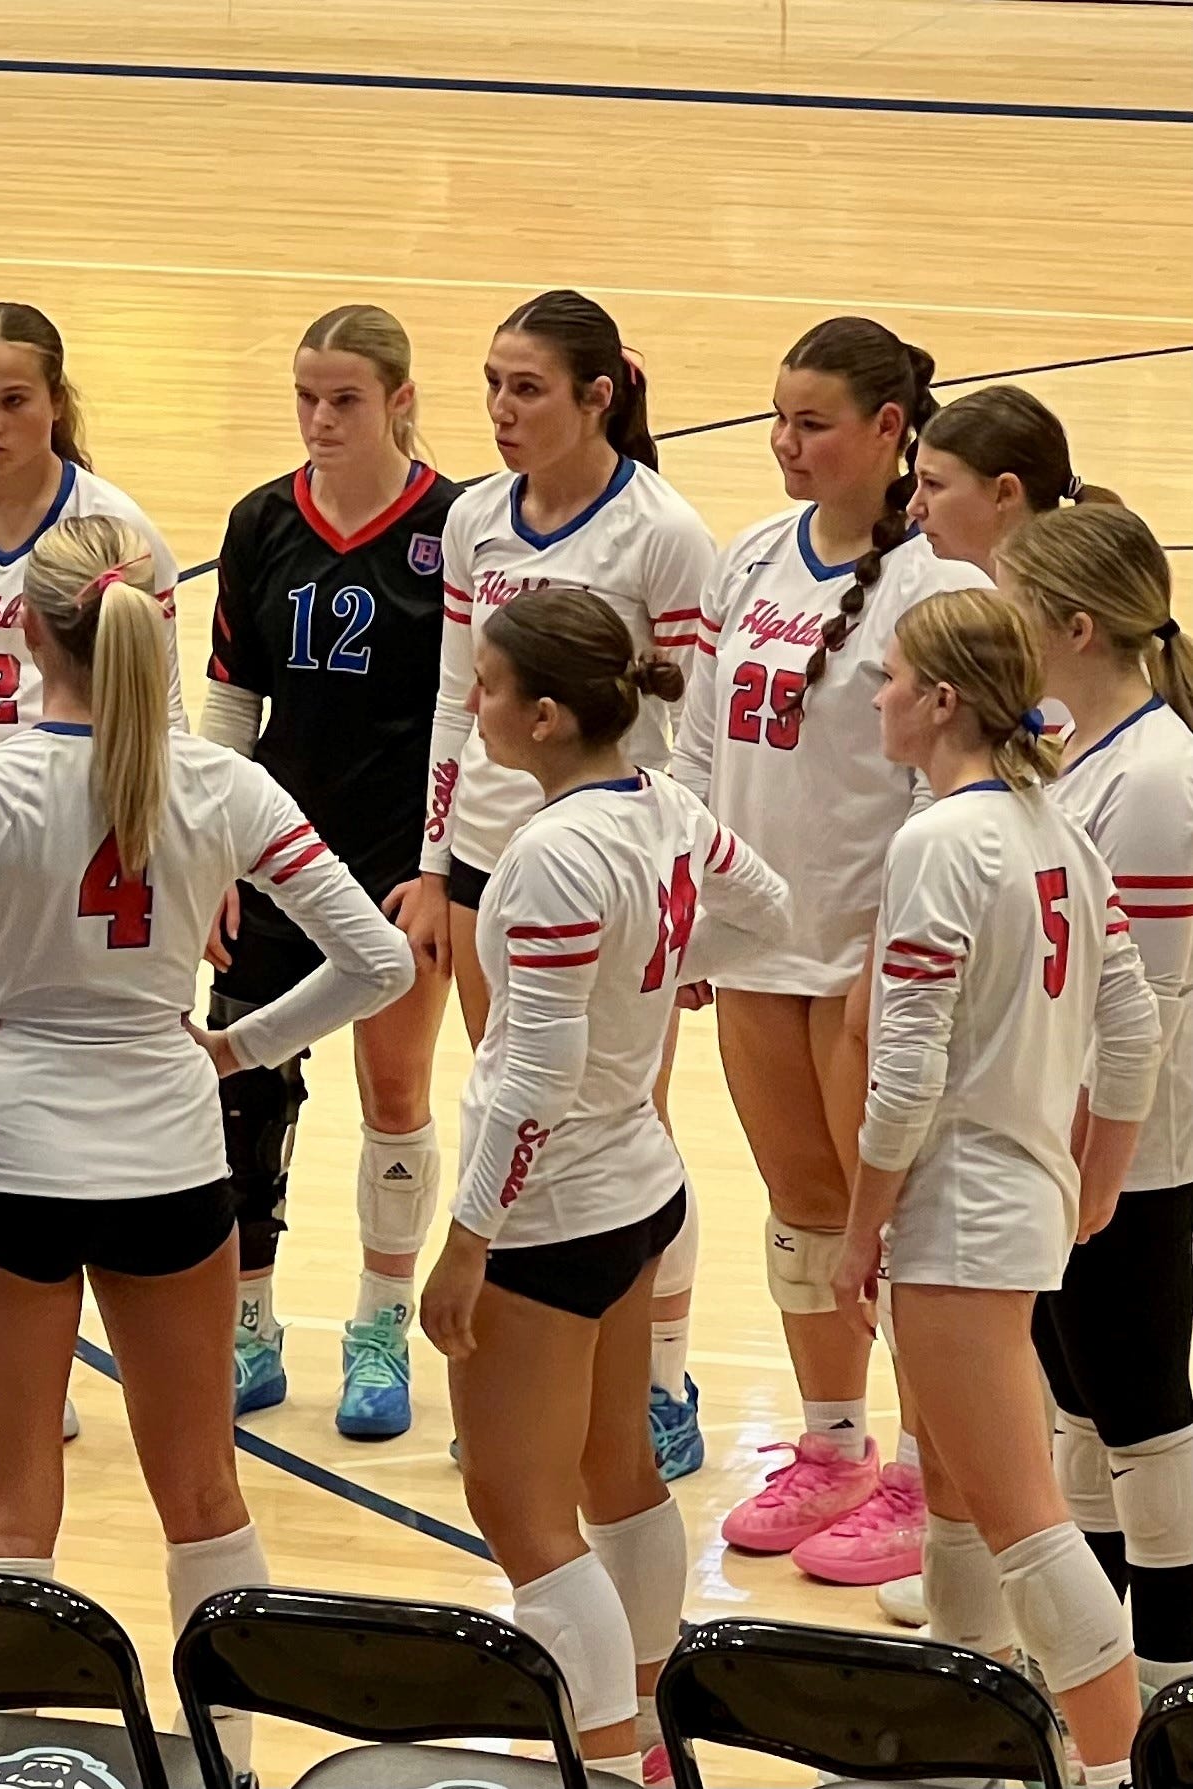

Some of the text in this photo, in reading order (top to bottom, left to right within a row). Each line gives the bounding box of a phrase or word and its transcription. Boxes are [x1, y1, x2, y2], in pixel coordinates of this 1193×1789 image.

[287, 582, 376, 674] 12
[728, 661, 804, 751] 25
[78, 824, 154, 949] 4
[1035, 867, 1069, 1000] 5
